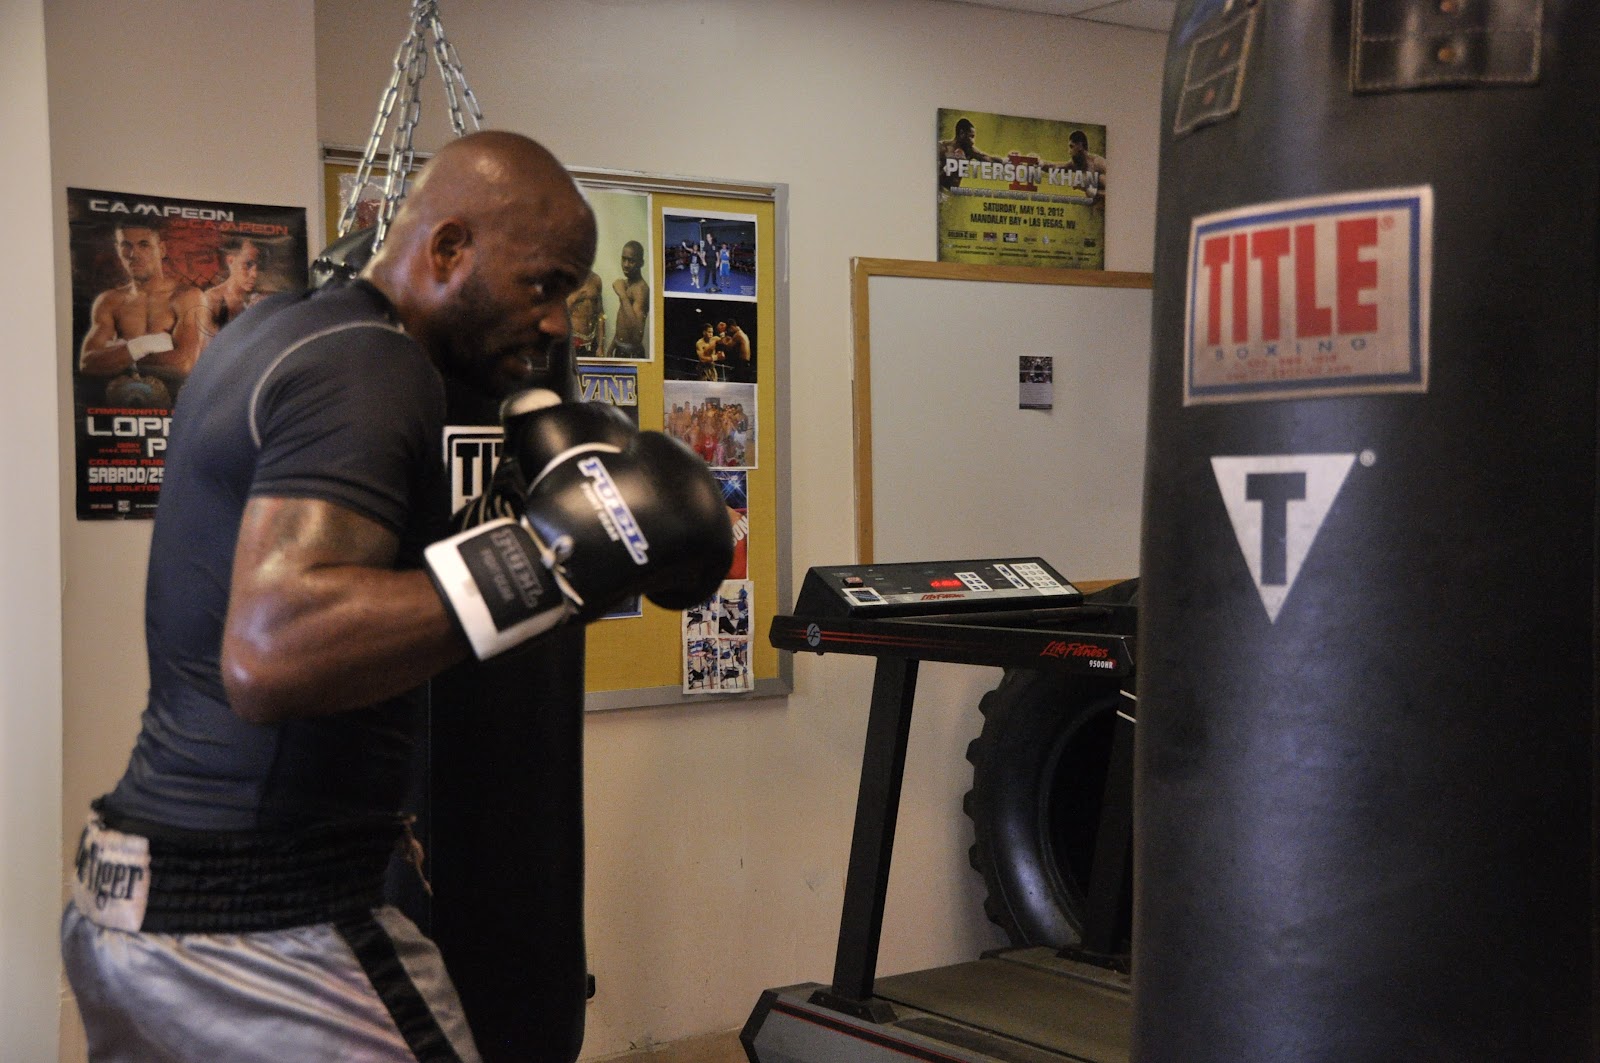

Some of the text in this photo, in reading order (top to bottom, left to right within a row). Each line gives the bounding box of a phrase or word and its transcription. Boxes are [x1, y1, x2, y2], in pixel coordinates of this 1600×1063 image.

[945, 158, 1099, 188] PETERSON KHAN
[89, 199, 234, 222] CAMPEON
[970, 213, 1007, 225] MANDALAY
[1009, 216, 1022, 226] BAY
[1029, 218, 1041, 227] LAS
[983, 202, 1018, 215] SATURDAY,
[1019, 205, 1034, 215] MAY
[1048, 207, 1065, 217] 2012
[1204, 217, 1378, 346] TITLE
[1215, 338, 1367, 361] BOXING
[577, 374, 638, 406] ZINE
[1088, 659, 1114, 669] 9500HR
